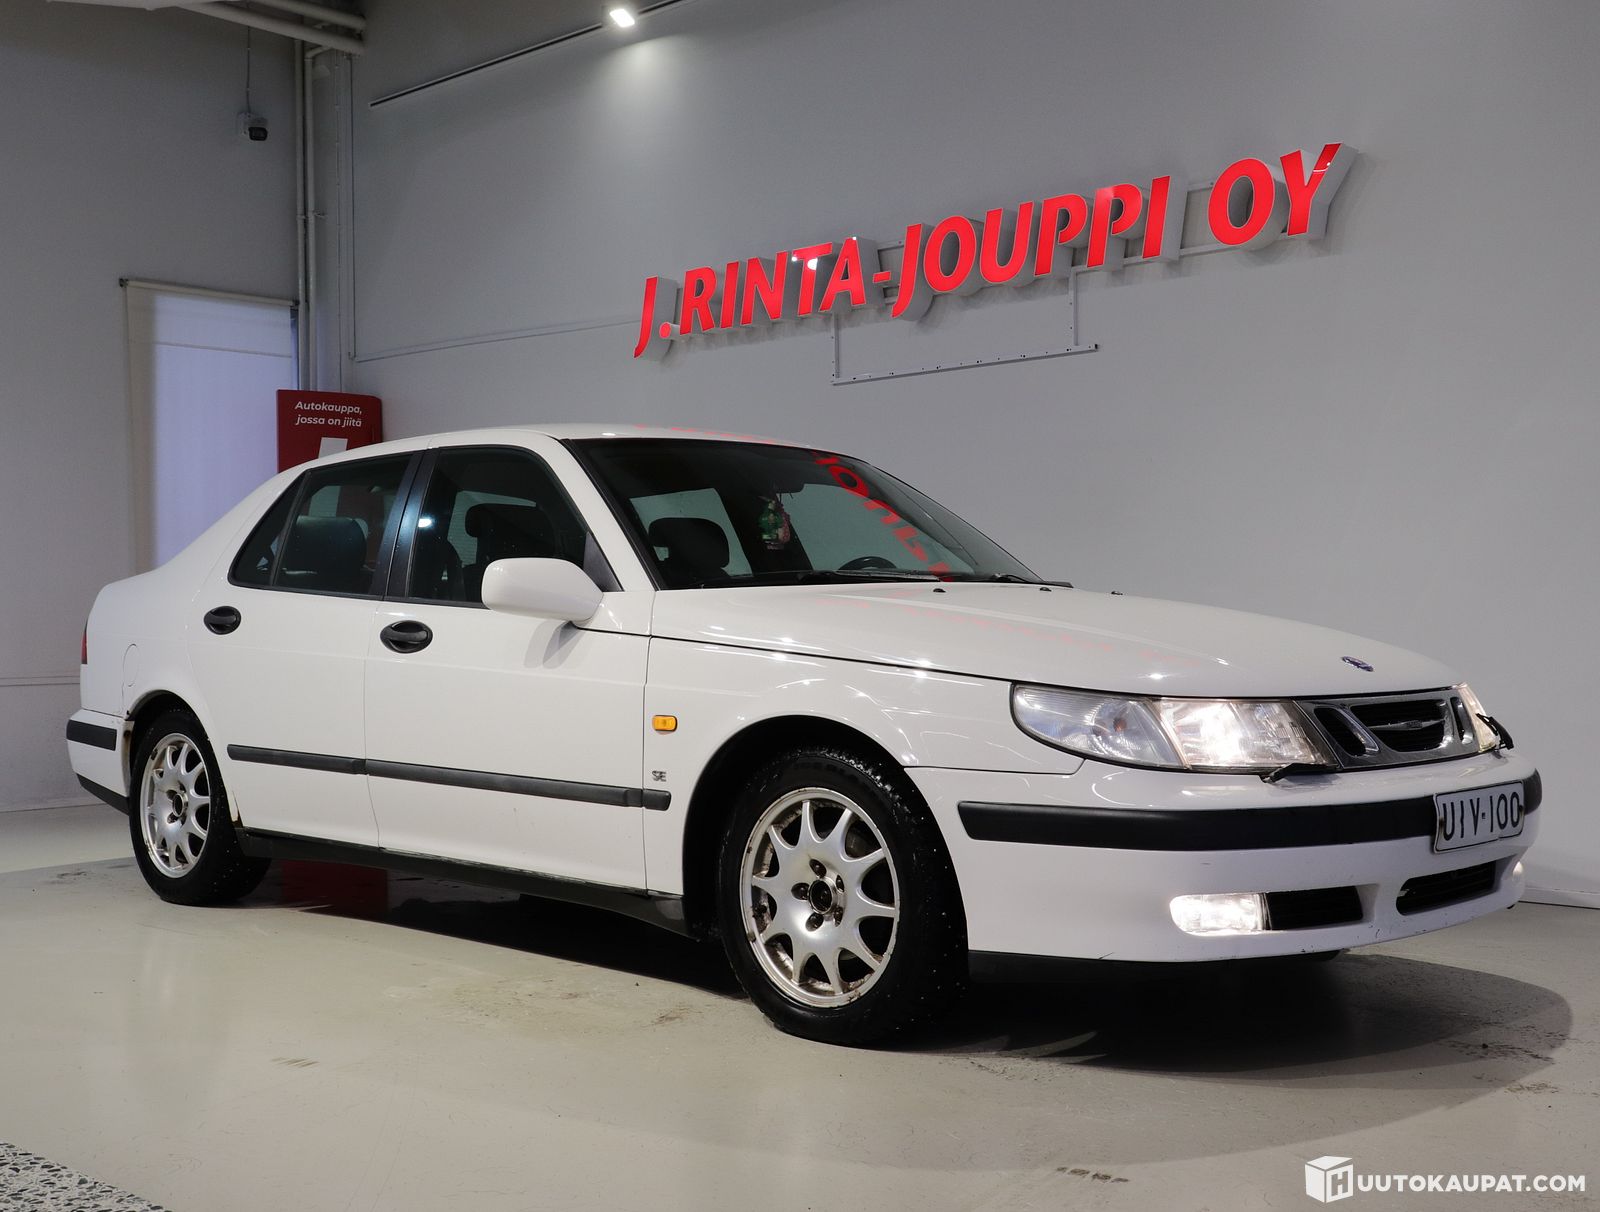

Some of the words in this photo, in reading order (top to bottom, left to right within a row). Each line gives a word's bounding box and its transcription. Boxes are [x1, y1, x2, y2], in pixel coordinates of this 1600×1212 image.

[633, 175, 1172, 359] J.RINTA-JOUPPI
[1208, 142, 1343, 246] OY
[294, 401, 362, 415] Autokauppa,
[295, 414, 325, 426] jossa
[341, 417, 362, 428] jiitä
